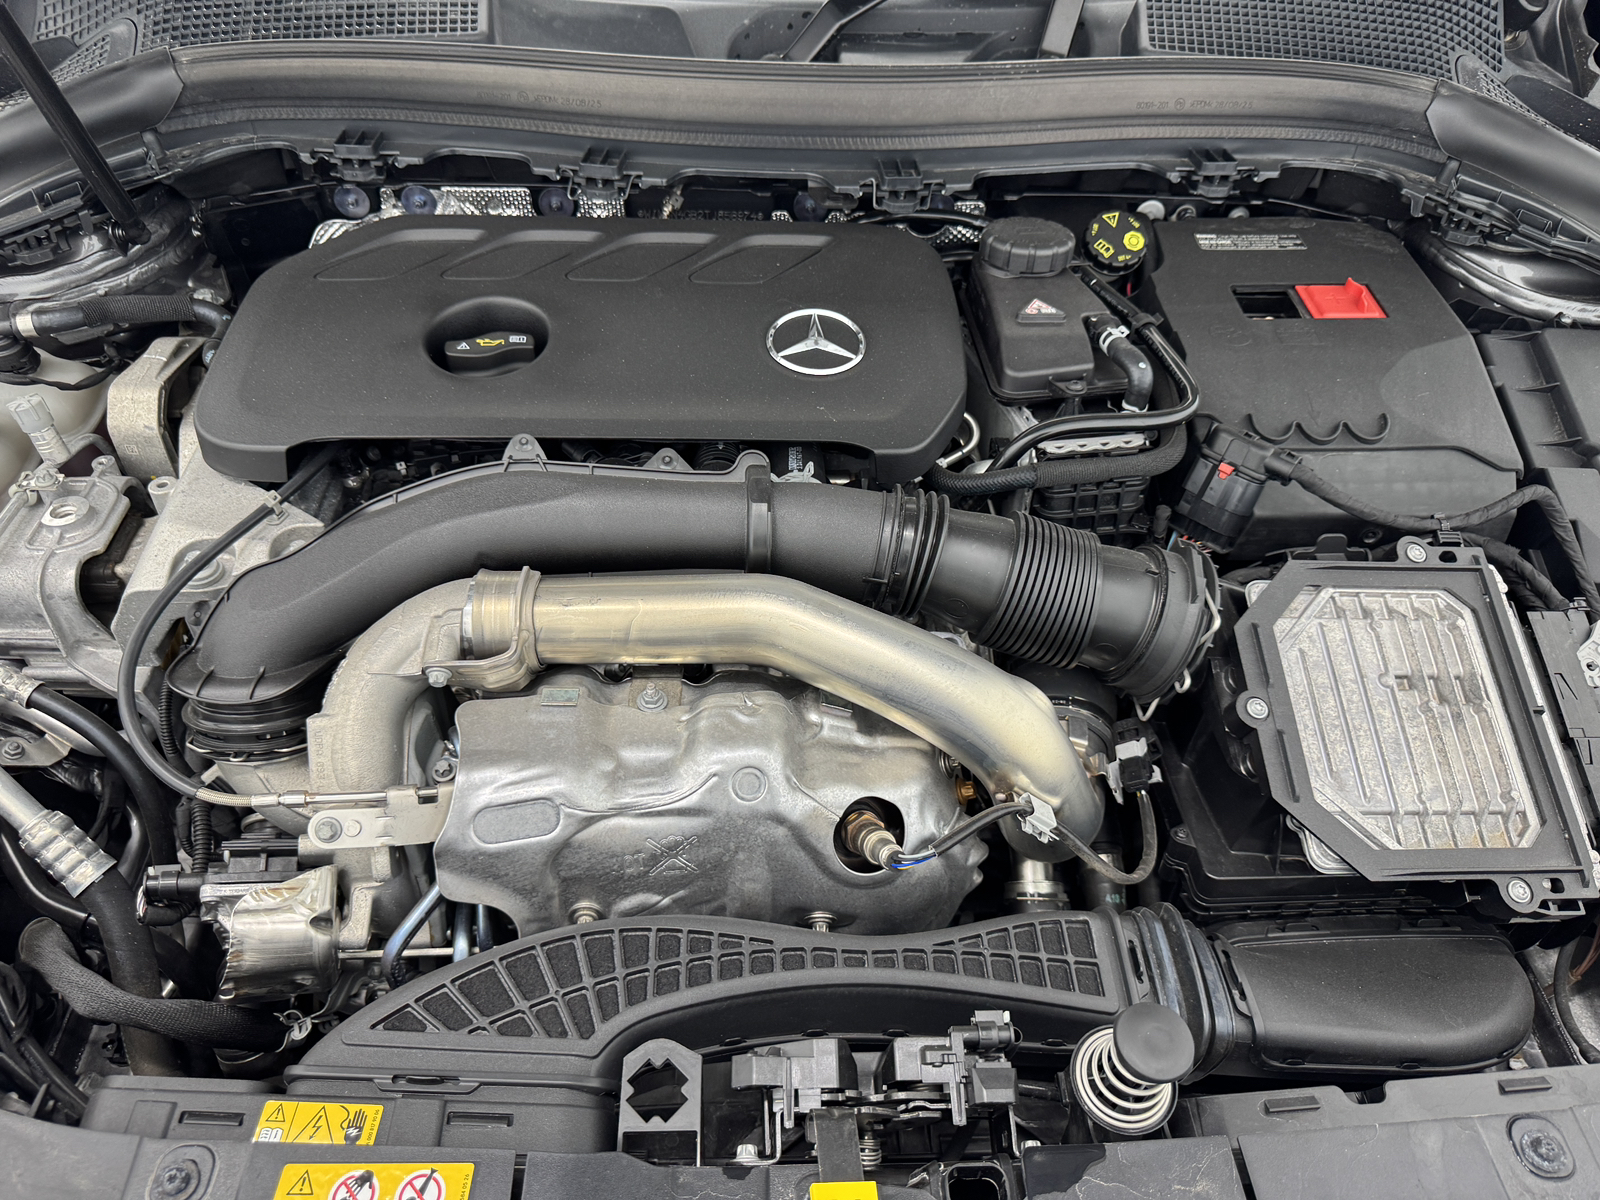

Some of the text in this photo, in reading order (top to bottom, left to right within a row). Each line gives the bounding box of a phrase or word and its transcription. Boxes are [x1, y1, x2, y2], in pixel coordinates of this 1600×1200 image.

[560, 97, 602, 108] 28/08/25
[463, 1173, 470, 1181] 26
[461, 1181, 468, 1190] 05
